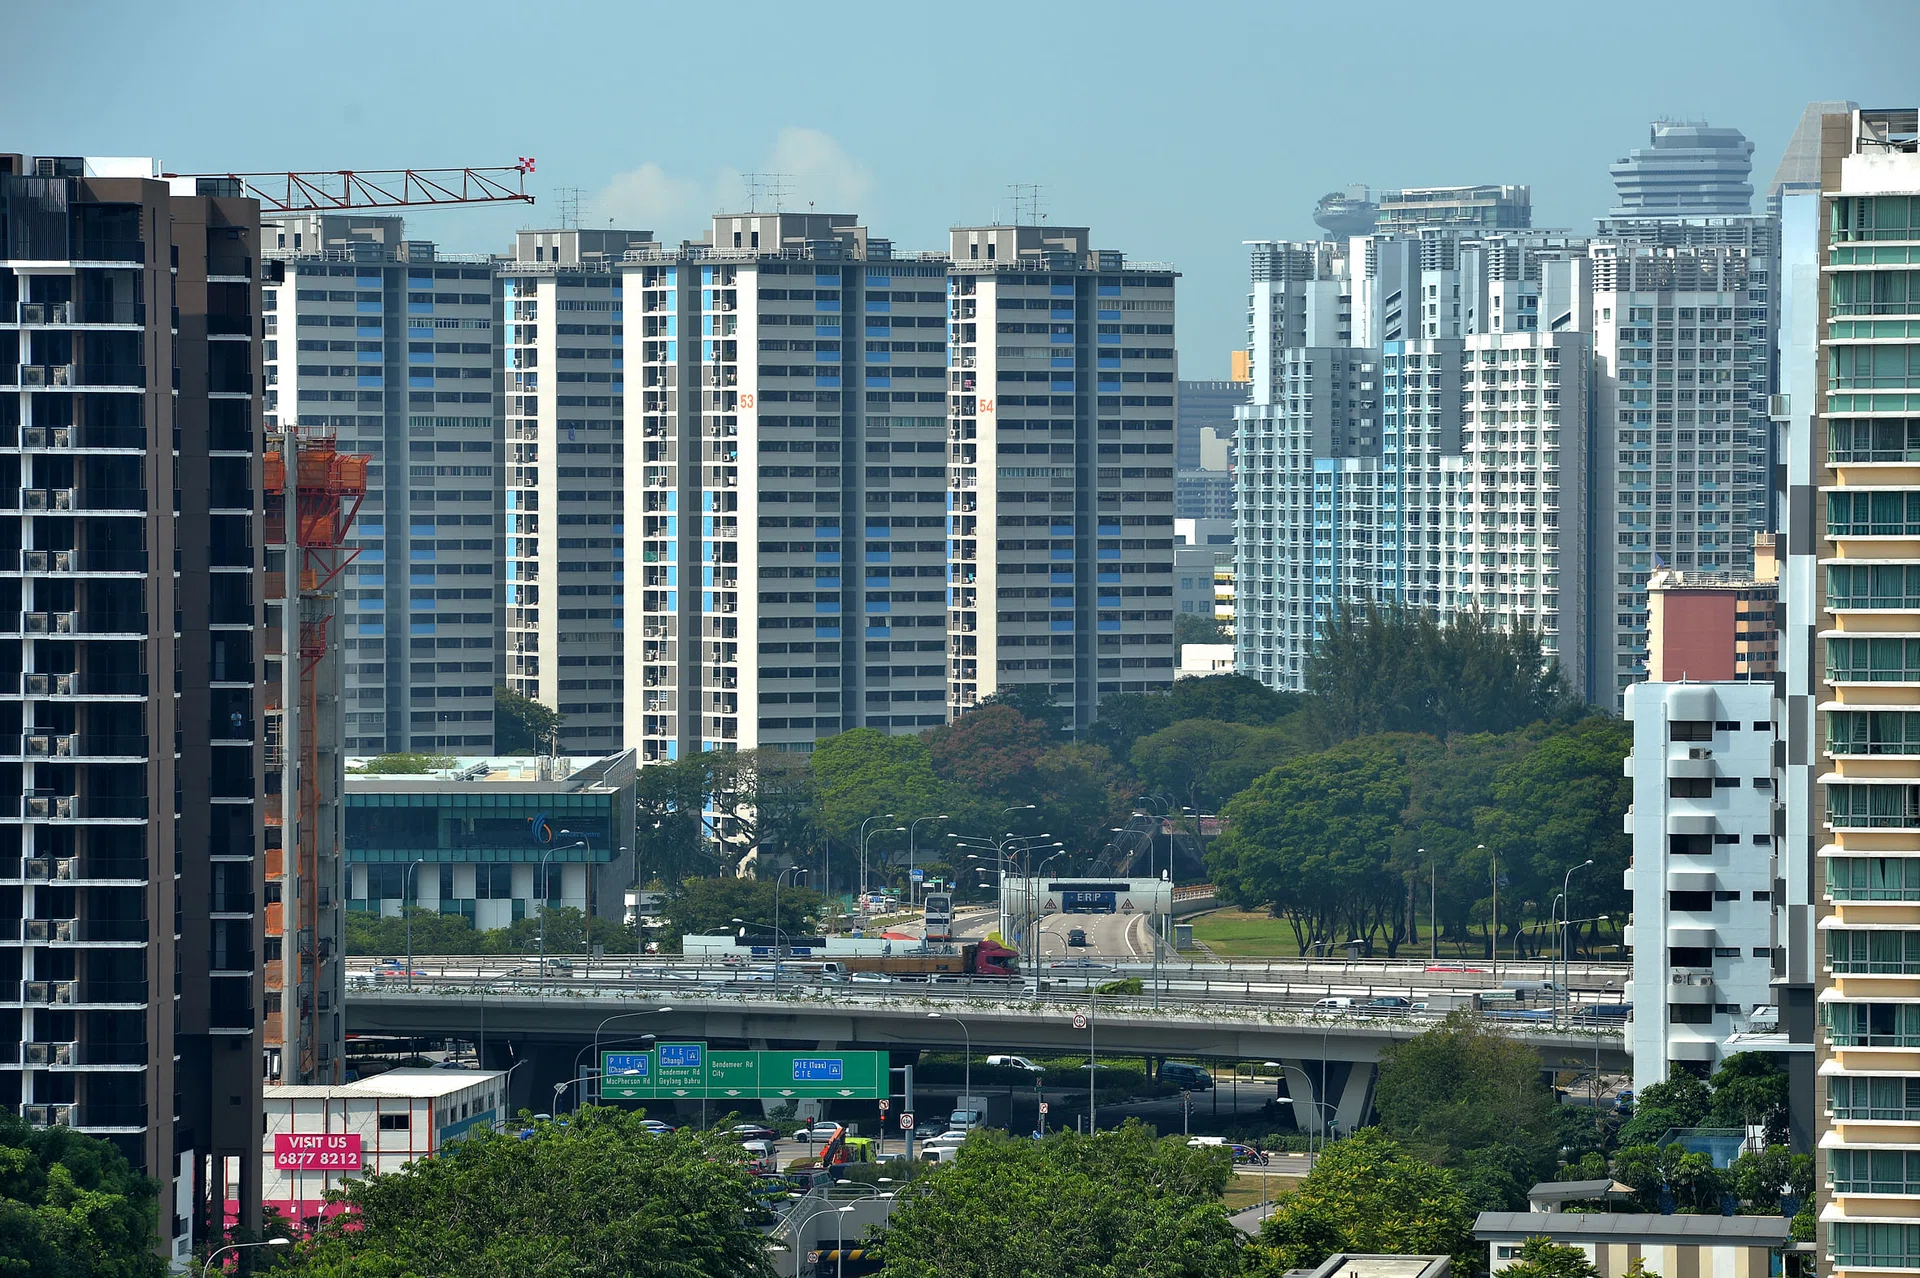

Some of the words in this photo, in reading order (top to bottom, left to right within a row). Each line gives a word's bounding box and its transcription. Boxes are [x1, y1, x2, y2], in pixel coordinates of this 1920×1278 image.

[740, 394, 754, 408] 53
[980, 399, 994, 414] 54
[1078, 893, 1101, 902] ERP
[662, 1056, 684, 1066] (Changi)
[712, 1070, 724, 1078] City
[658, 1078, 682, 1086] Geylang
[288, 1136, 324, 1148] VISIT
[328, 1136, 347, 1148] US
[278, 1152, 316, 1164] 6877
[320, 1152, 357, 1164] 8212
